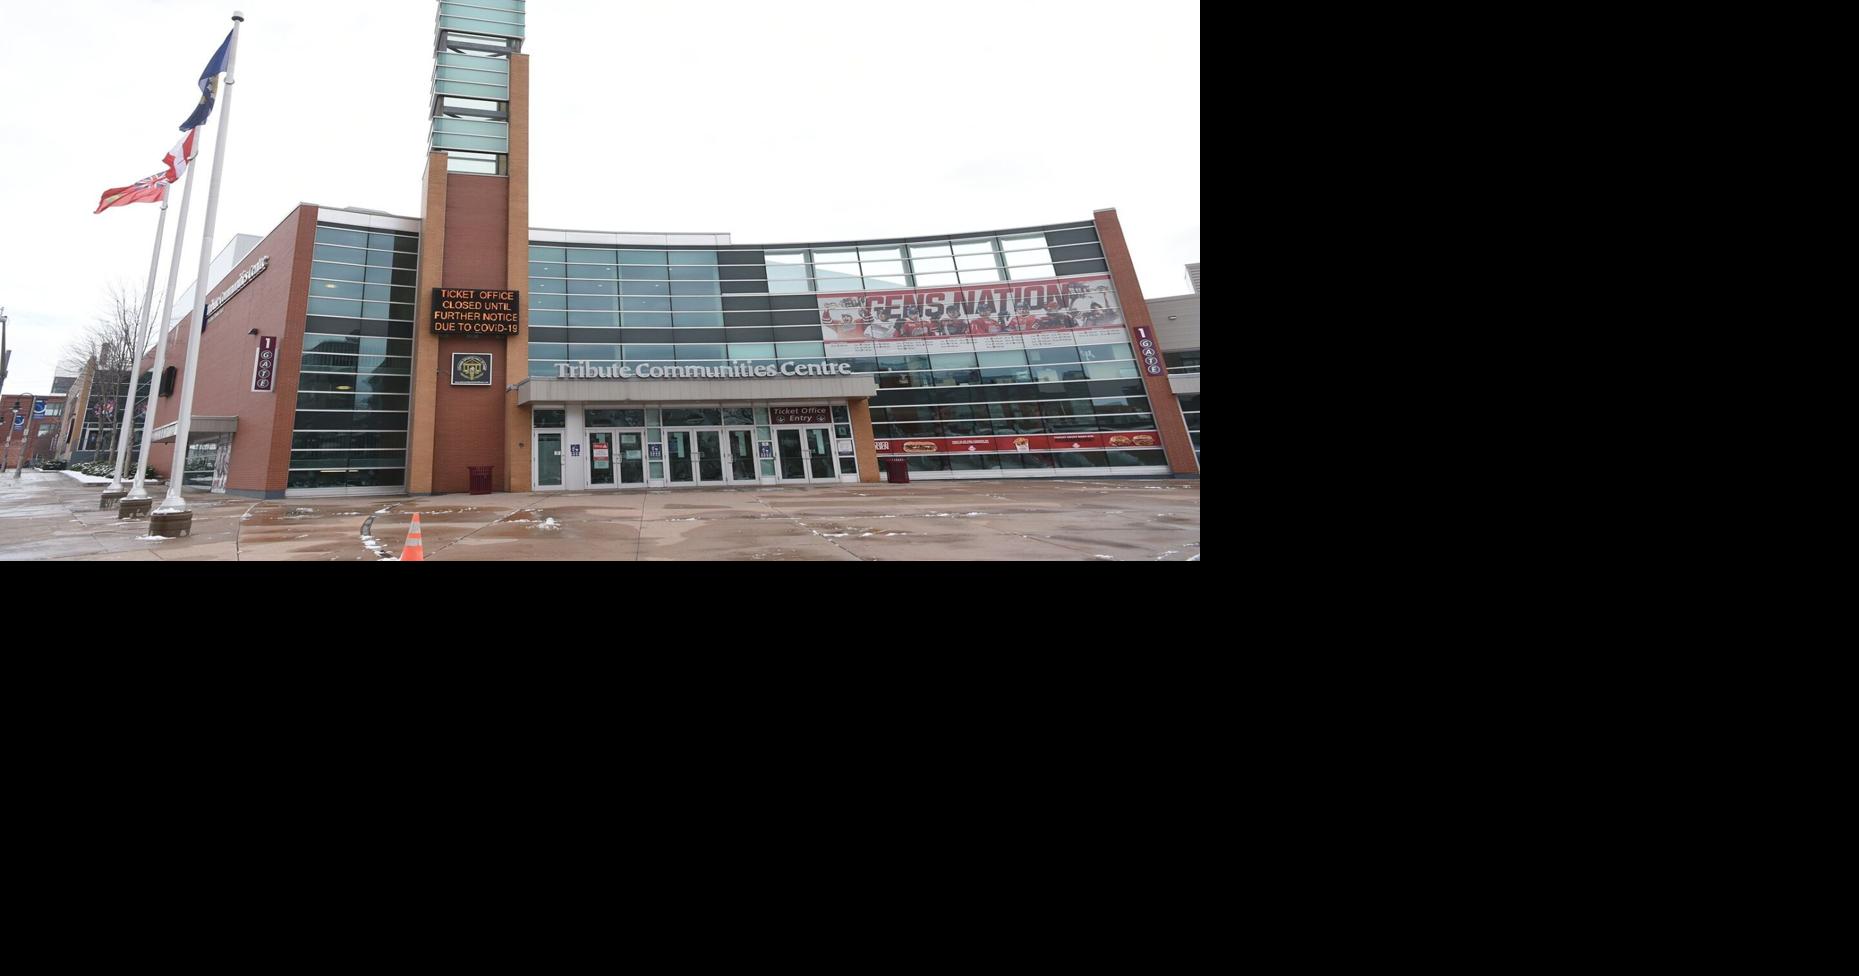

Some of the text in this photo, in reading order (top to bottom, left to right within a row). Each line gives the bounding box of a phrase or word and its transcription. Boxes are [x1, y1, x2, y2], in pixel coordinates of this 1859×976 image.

[441, 289, 514, 300] TICKET OFFICE
[442, 300, 511, 311] CLOSED UNTIL
[865, 283, 1070, 320] GENS NATION
[434, 311, 518, 322] FURTHER NOTICE
[434, 322, 456, 331] DUE
[458, 322, 472, 332] TO
[1138, 328, 1146, 338] 1
[265, 338, 271, 349] 1
[1141, 340, 1158, 373] GATE
[258, 350, 271, 388] GATE
[554, 360, 851, 378] Tribute Communities Centre
